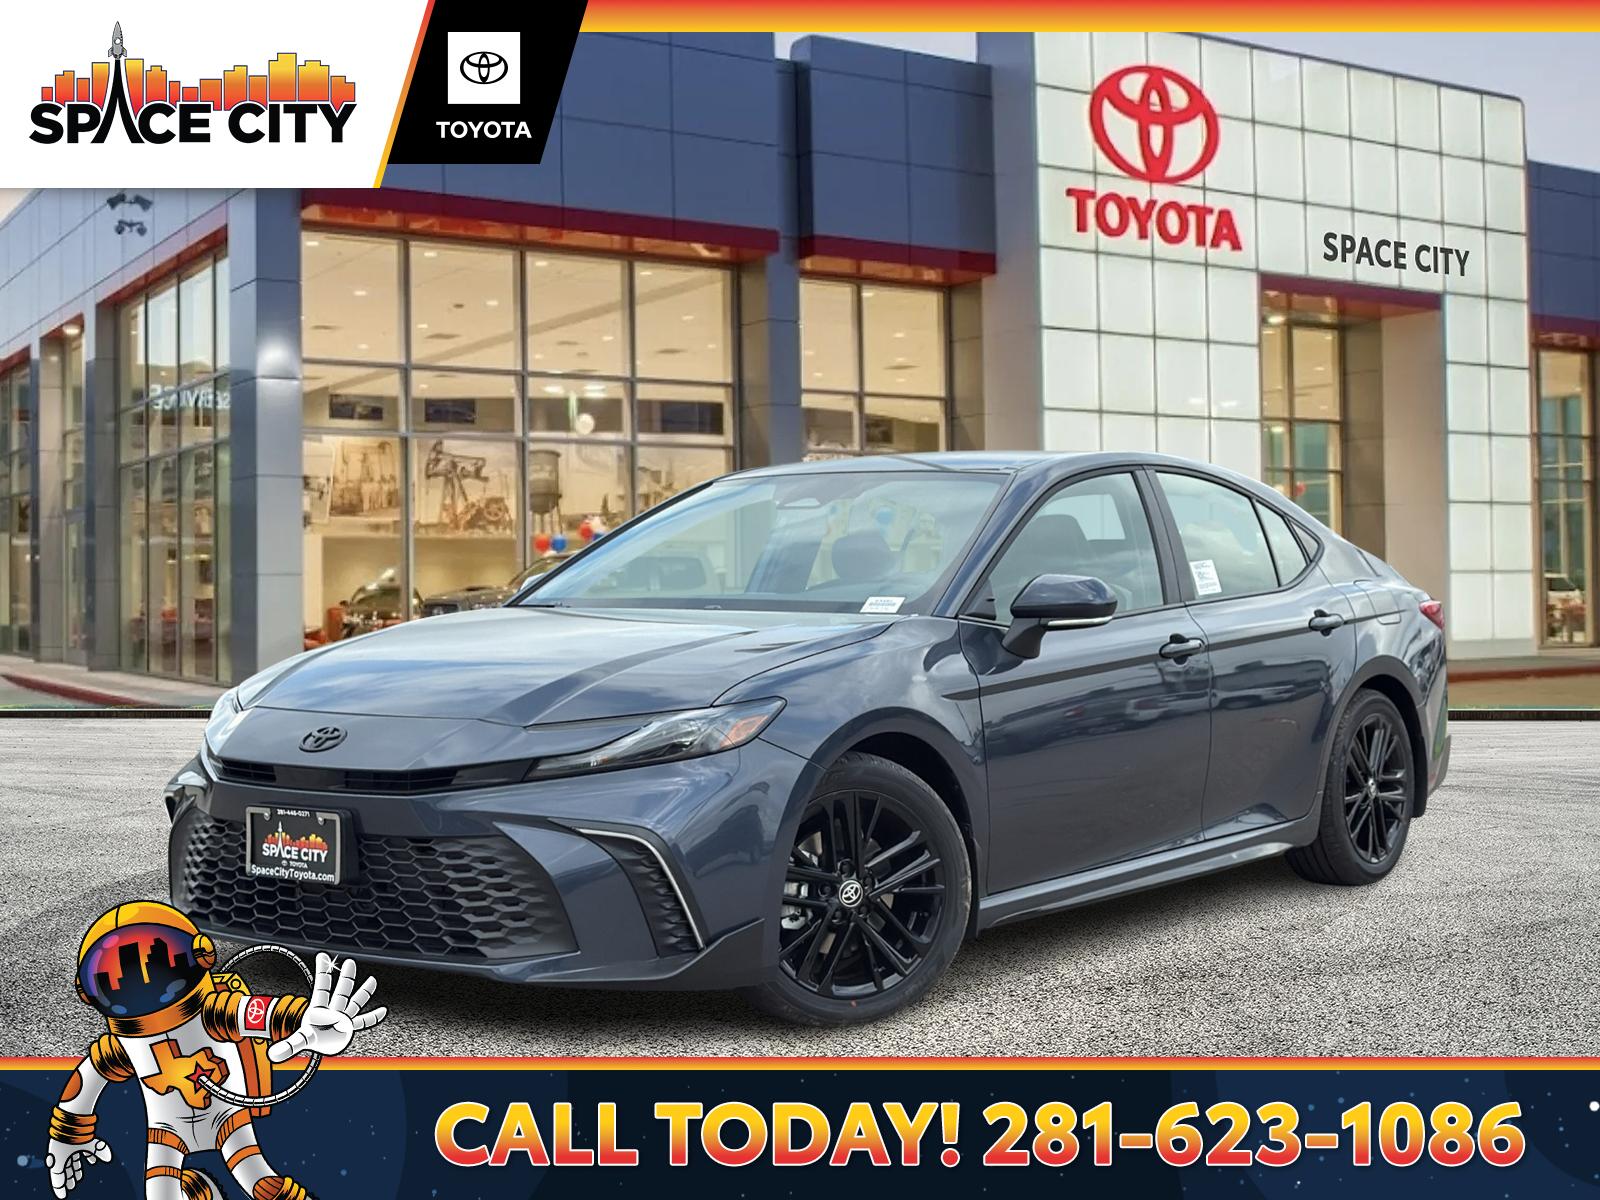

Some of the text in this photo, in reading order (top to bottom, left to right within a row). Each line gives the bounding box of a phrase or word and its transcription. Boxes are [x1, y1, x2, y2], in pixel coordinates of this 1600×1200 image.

[1066, 188, 1242, 250] TOYOTA
[1323, 232, 1470, 277] SPACE CITY
[262, 843, 328, 863] SPACE CITY
[251, 864, 335, 882] SpaceCityToyota.com
[289, 861, 308, 869] TOYOTA
